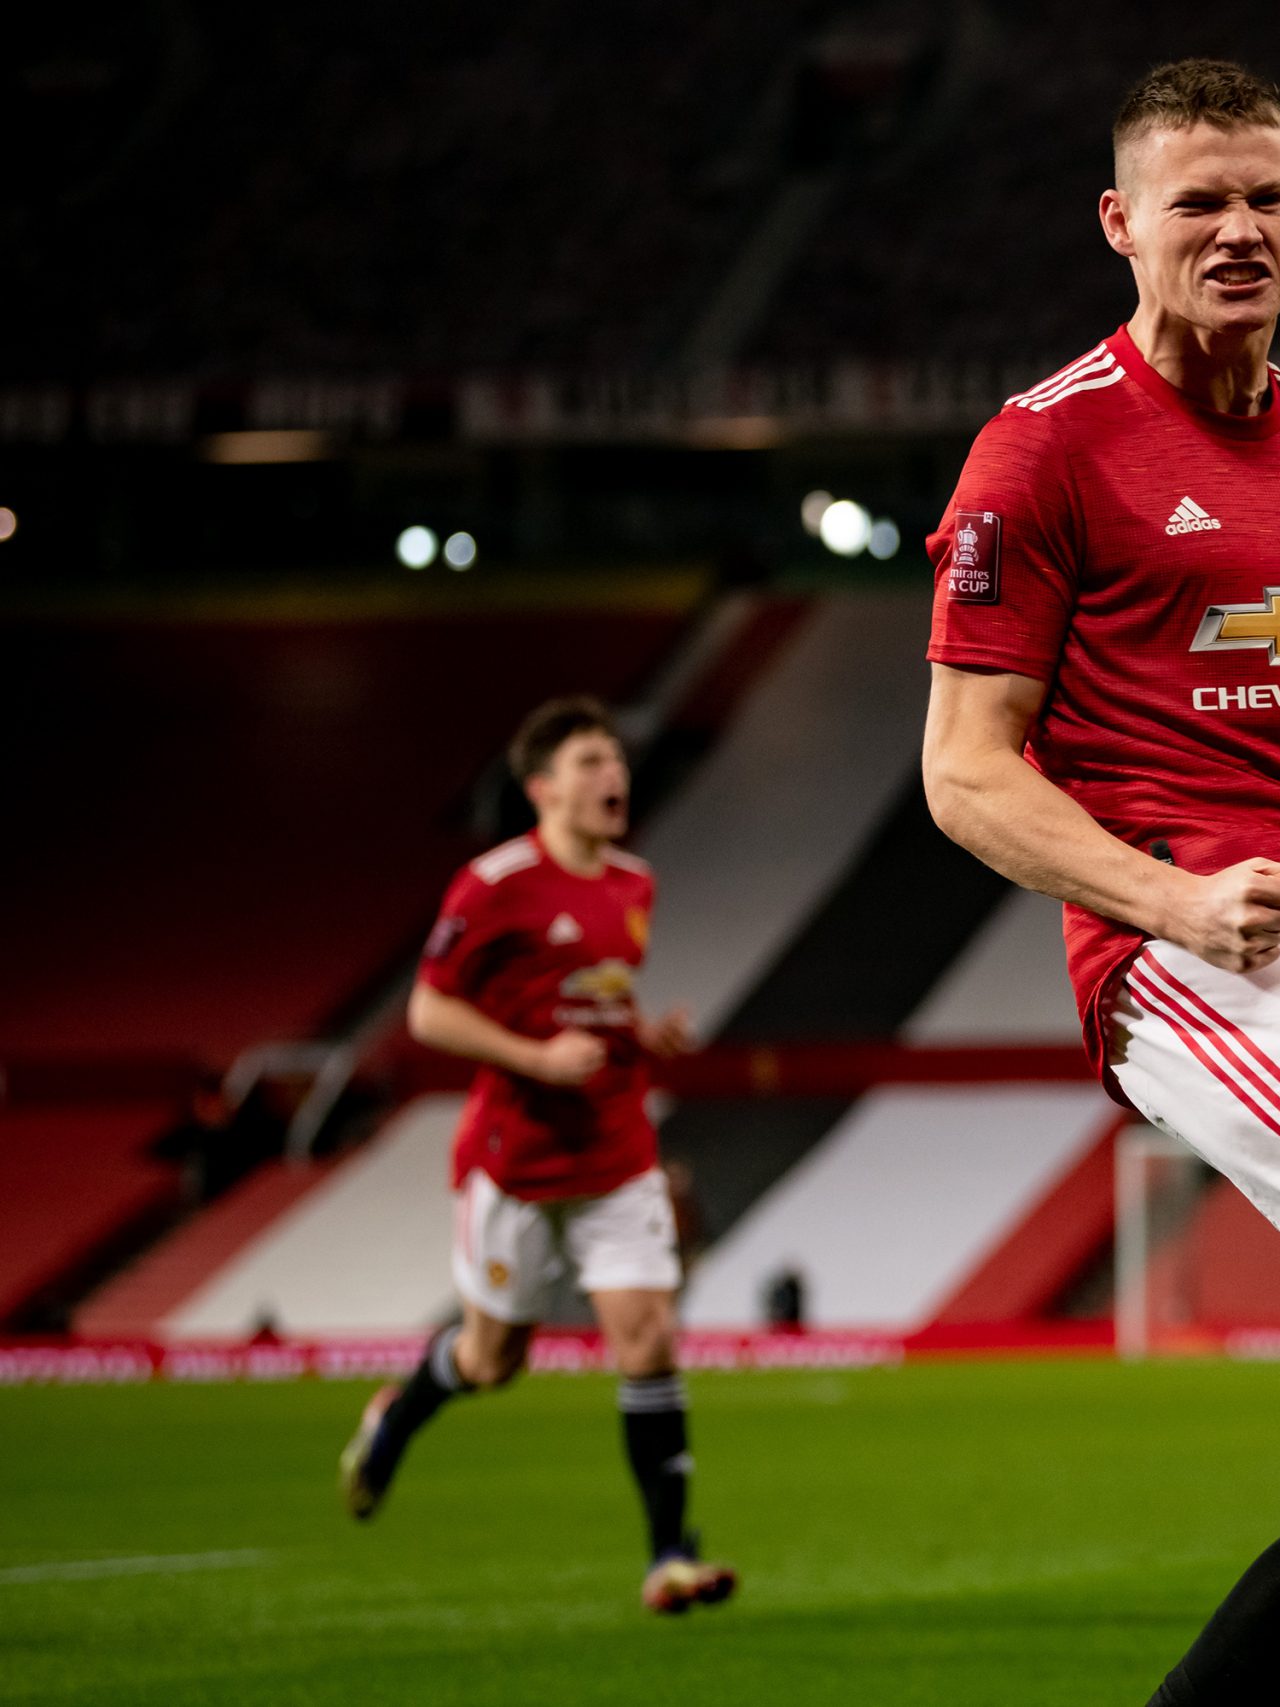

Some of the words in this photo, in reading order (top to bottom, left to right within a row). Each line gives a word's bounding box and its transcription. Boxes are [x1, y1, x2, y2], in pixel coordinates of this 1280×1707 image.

[1165, 518, 1221, 536] adidas
[950, 567, 990, 580] mirates
[958, 580, 990, 593] CUP
